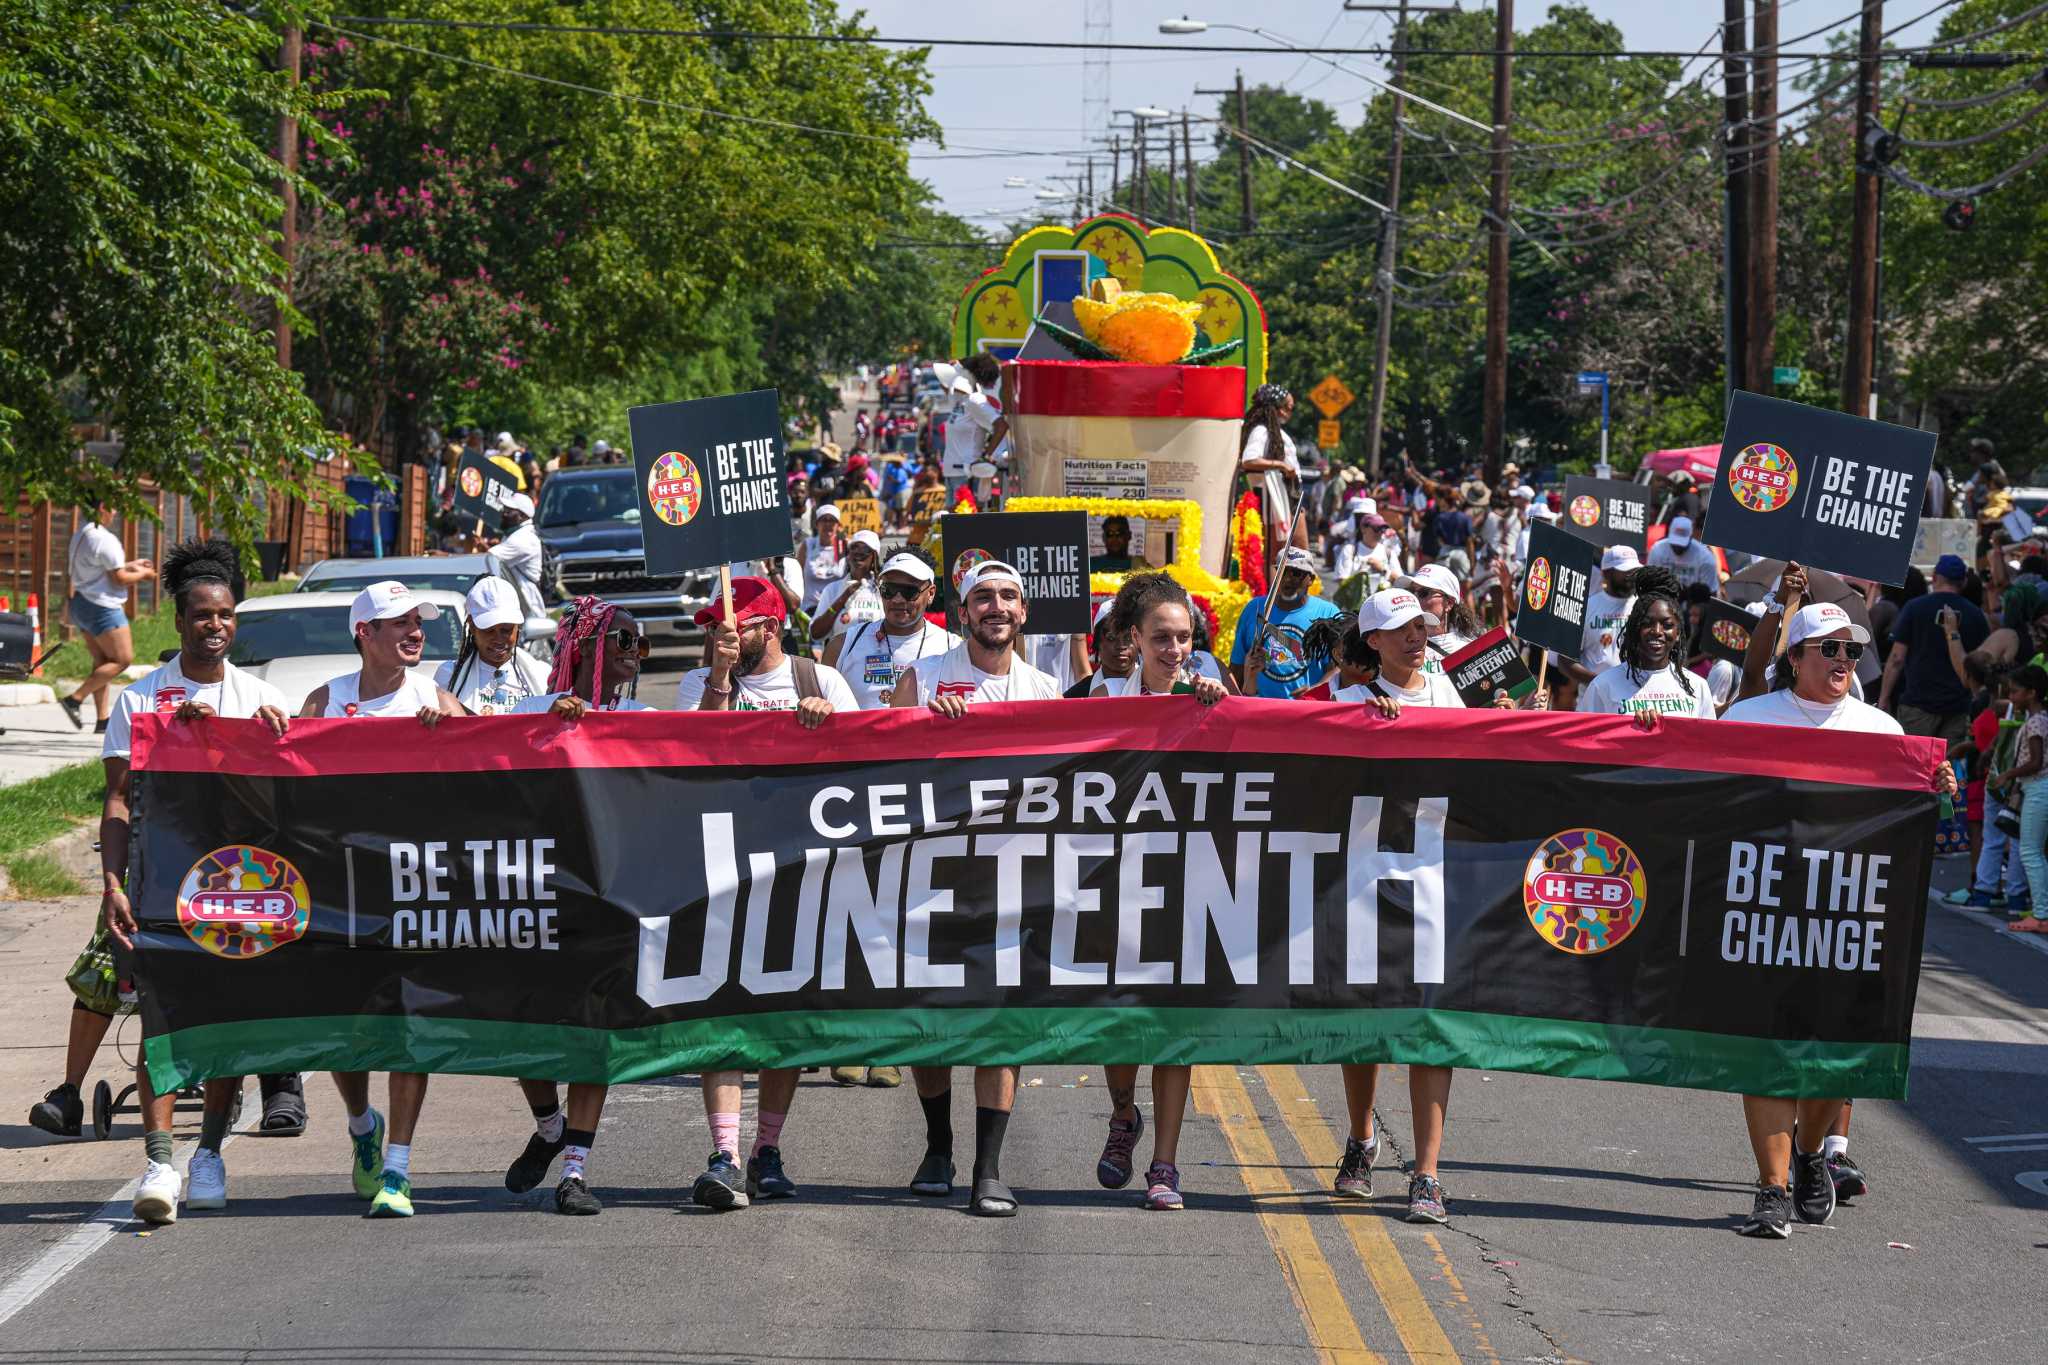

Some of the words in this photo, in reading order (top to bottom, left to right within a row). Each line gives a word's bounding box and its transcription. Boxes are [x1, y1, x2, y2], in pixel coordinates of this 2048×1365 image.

[715, 443, 740, 481] BE
[742, 438, 777, 477] THE
[1064, 460, 1113, 469] Nutrition
[1115, 461, 1146, 470] Facts
[719, 477, 780, 515] CHANGE
[1122, 488, 1146, 498] 230
[1822, 456, 1860, 495] BE
[1864, 465, 1914, 509] THE
[1608, 498, 1624, 516] BE
[1624, 500, 1646, 520] THE
[1608, 515, 1645, 534] CHANGE
[1815, 493, 1905, 540] CHANGE
[1016, 546, 1039, 574] BE
[1044, 545, 1079, 573] THE
[1021, 575, 1081, 600] CHANGE
[1557, 565, 1570, 594] BE
[1570, 571, 1588, 601] THE
[1553, 594, 1584, 626] CHANGE
[1455, 643, 1517, 690] JUNETEENTH
[809, 771, 1274, 838] CELEBRATE
[389, 841, 448, 902] BE
[464, 838, 557, 902] THE
[1725, 840, 1787, 907] BE
[1801, 847, 1892, 914] THE
[202, 898, 285, 916] H-E-B
[636, 796, 1449, 1008] JUNETEENTH
[1545, 879, 1623, 902] H-E-B
[392, 907, 560, 951] CHANGE
[1720, 910, 1885, 972] CHANGE
